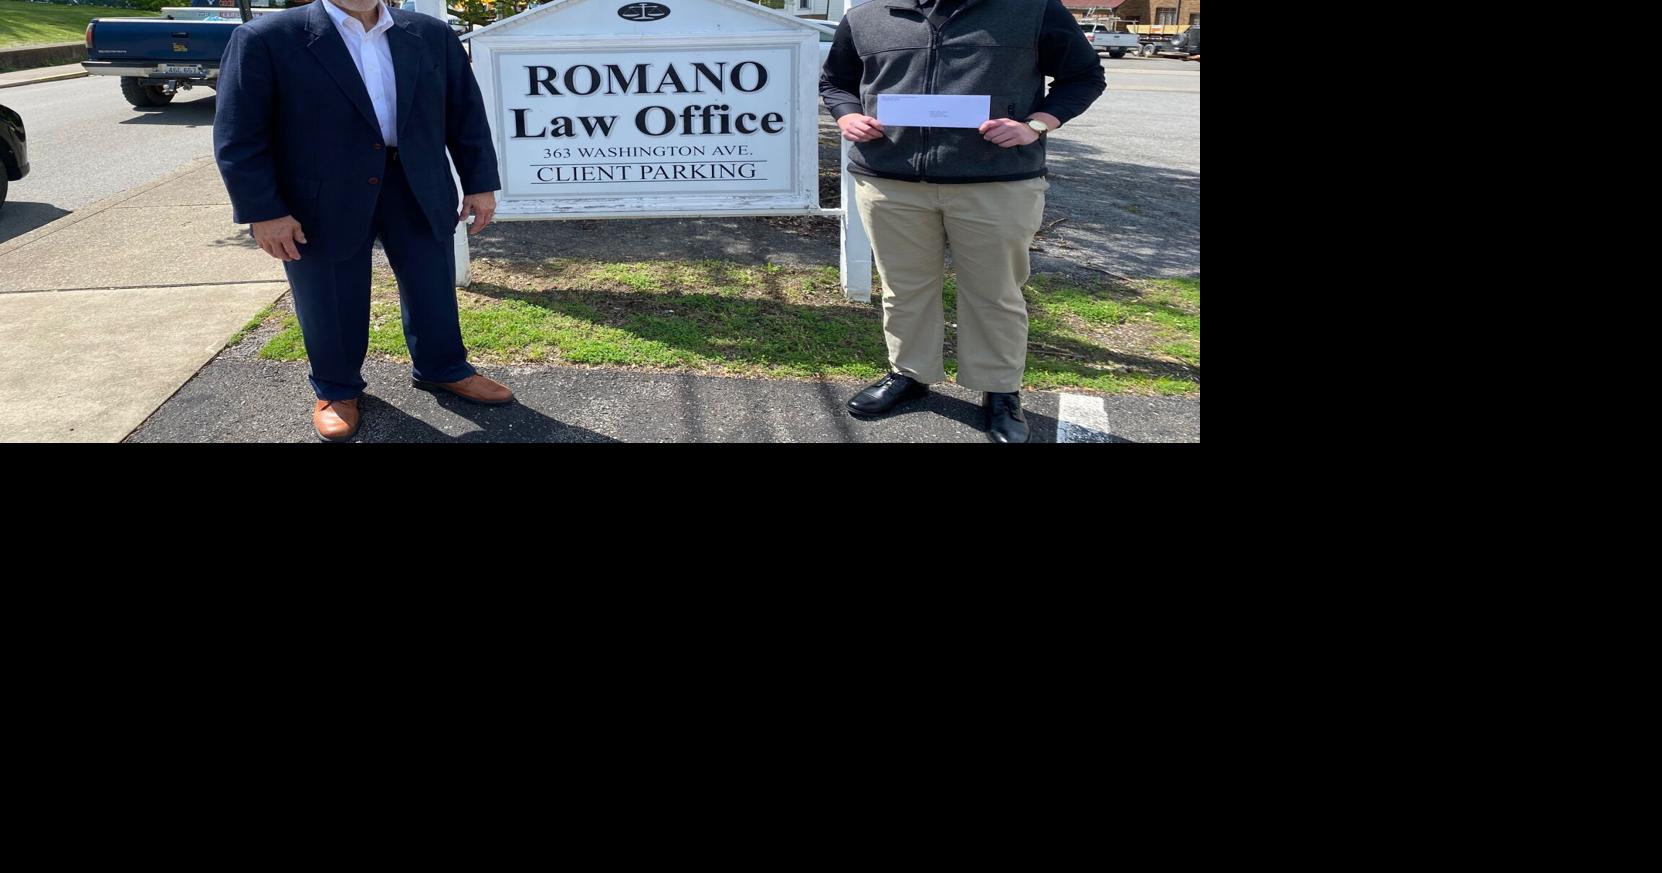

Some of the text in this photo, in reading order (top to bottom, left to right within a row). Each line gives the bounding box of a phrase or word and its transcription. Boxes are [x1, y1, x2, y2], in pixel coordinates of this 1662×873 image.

[524, 61, 768, 96] ROMANO
[509, 104, 784, 138] Law Office
[543, 145, 753, 159] 363 WASHINGTON AVE.
[537, 163, 756, 182] CLIENT PARKING
